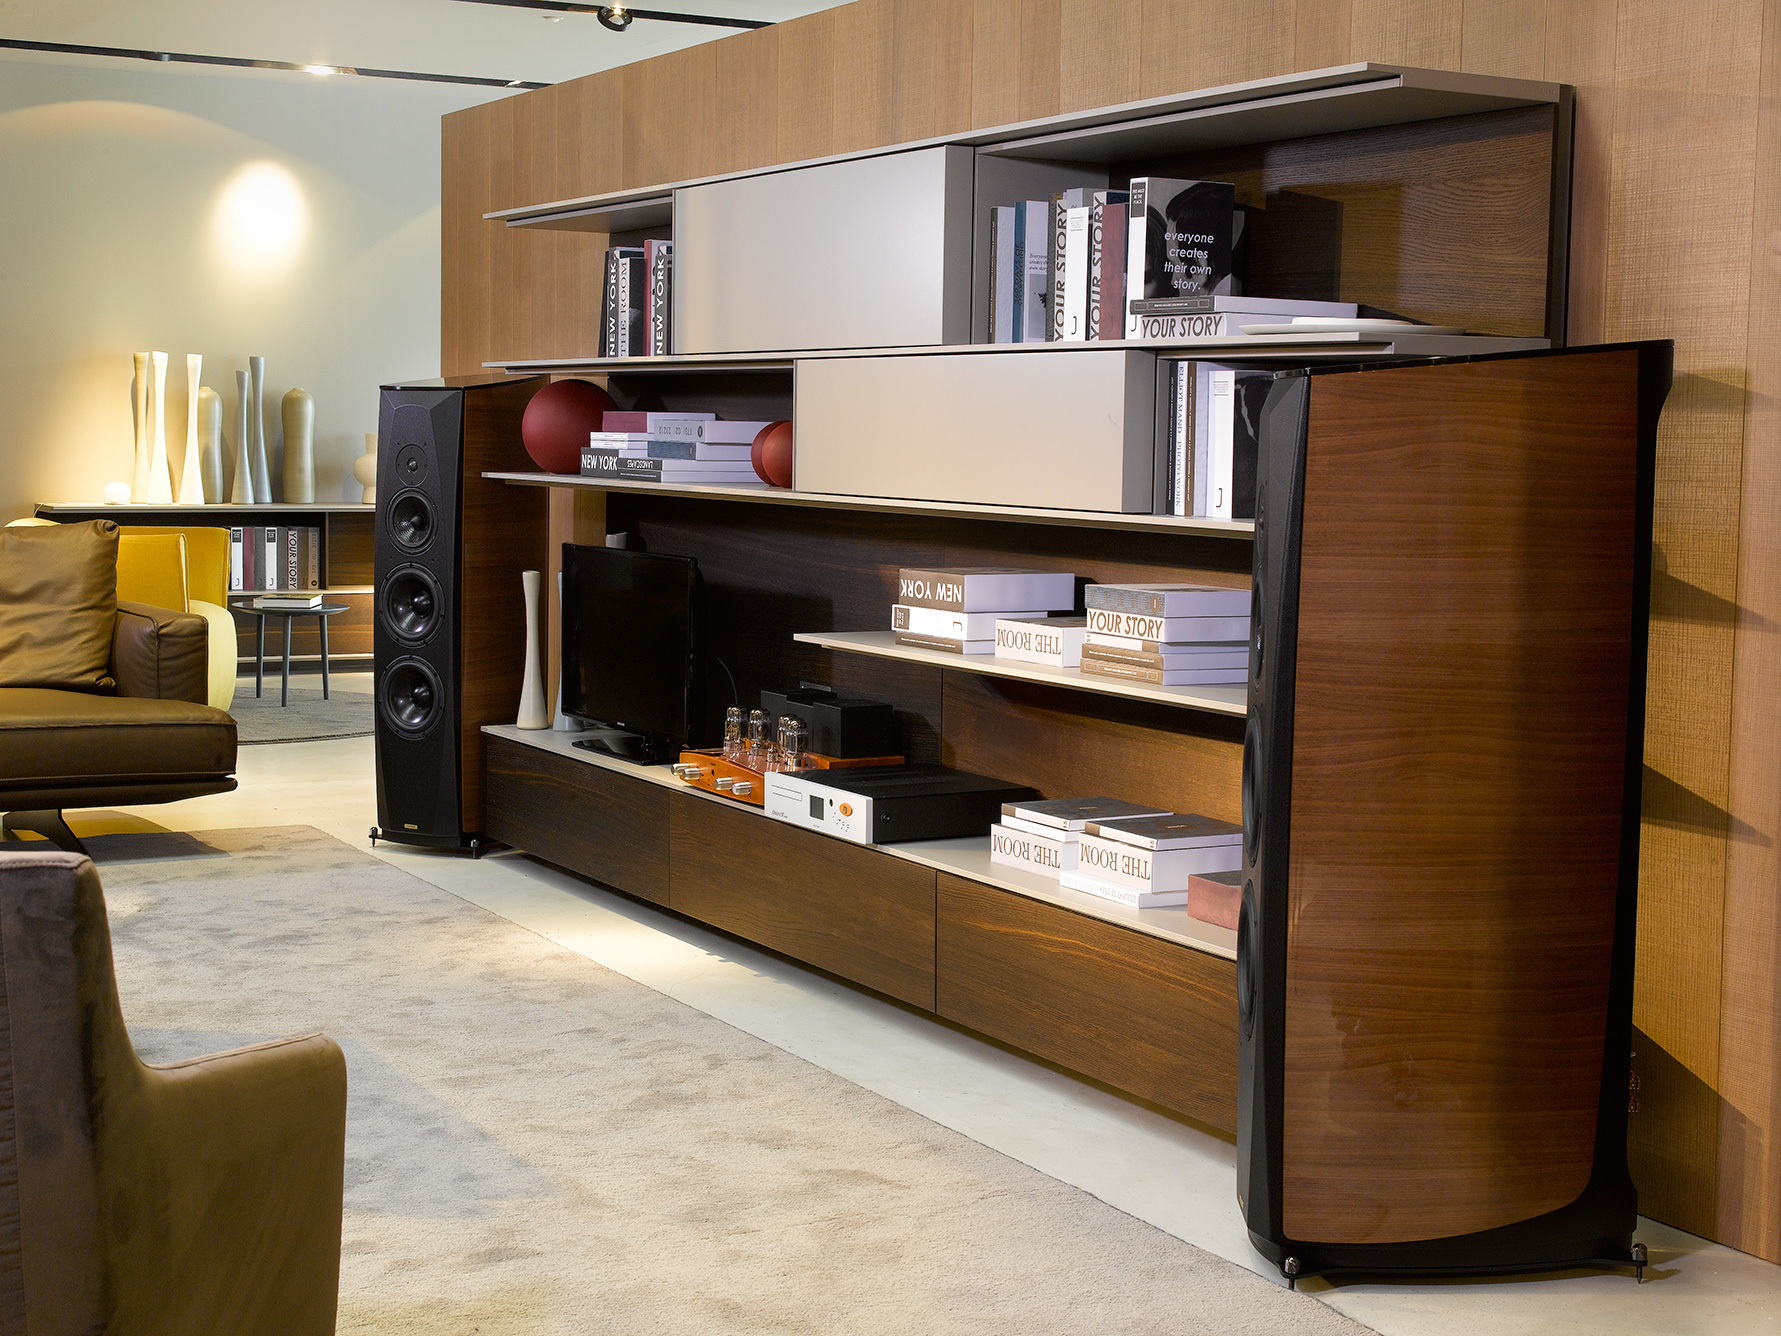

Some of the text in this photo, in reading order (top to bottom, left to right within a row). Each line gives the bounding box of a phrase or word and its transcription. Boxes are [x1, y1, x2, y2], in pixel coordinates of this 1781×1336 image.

[1164, 232, 1214, 247] everyone
[1169, 247, 1209, 259] creates
[1055, 202, 1066, 342] YOUR STORY
[1091, 196, 1105, 340] YOUR STORY
[1164, 261, 1212, 275] their own
[1173, 279, 1201, 292] story.
[609, 262, 618, 356] NEW YORK
[656, 258, 666, 355] NEW YORK
[1142, 315, 1223, 338] YOUR STORY
[581, 454, 618, 471] NEW YORK
[626, 459, 653, 469] LANDSCAPES
[289, 532, 297, 588] YOUR STORY
[900, 578, 962, 603] NEW YORK
[1089, 610, 1163, 639] YOUR STORY
[997, 628, 1062, 655] THE ROOM
[993, 833, 1061, 869] THE ROOM
[1080, 842, 1151, 880] THE ROOM
